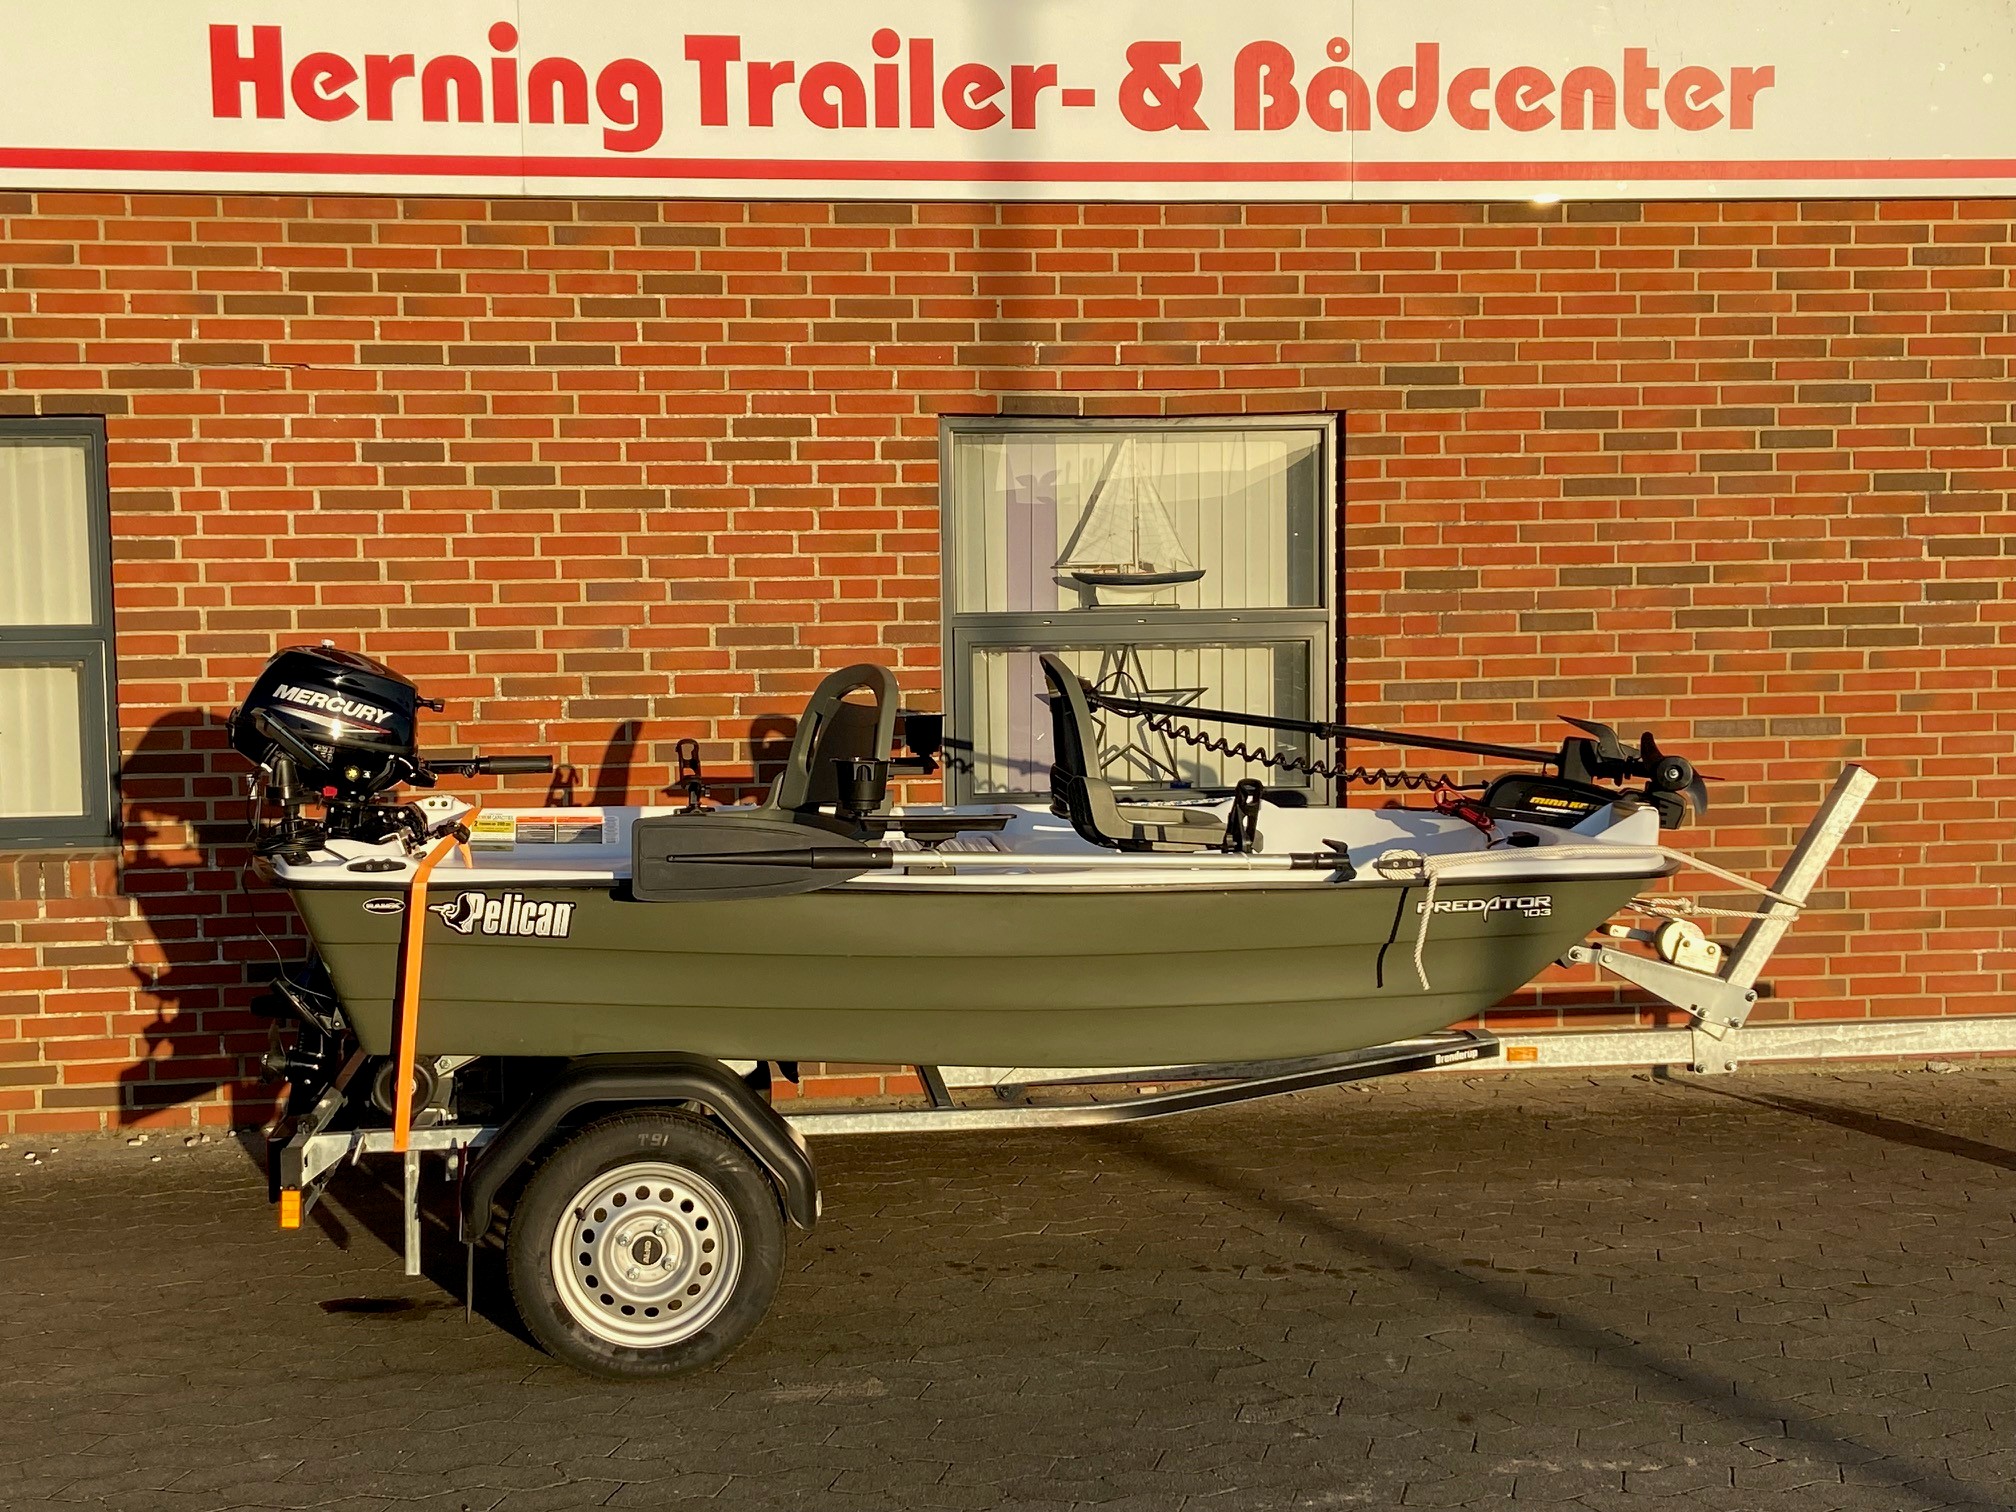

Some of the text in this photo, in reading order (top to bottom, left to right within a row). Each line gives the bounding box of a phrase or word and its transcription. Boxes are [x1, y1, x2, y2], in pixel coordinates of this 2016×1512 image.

[209, 21, 1776, 152] Herning Trailer- & Bådcenter
[272, 684, 394, 723] MERCURY
[469, 892, 571, 937] Pelican
[1416, 895, 1552, 922] PREDATOR
[1523, 908, 1552, 917] 103
[1434, 1049, 1478, 1065] Brenderup
